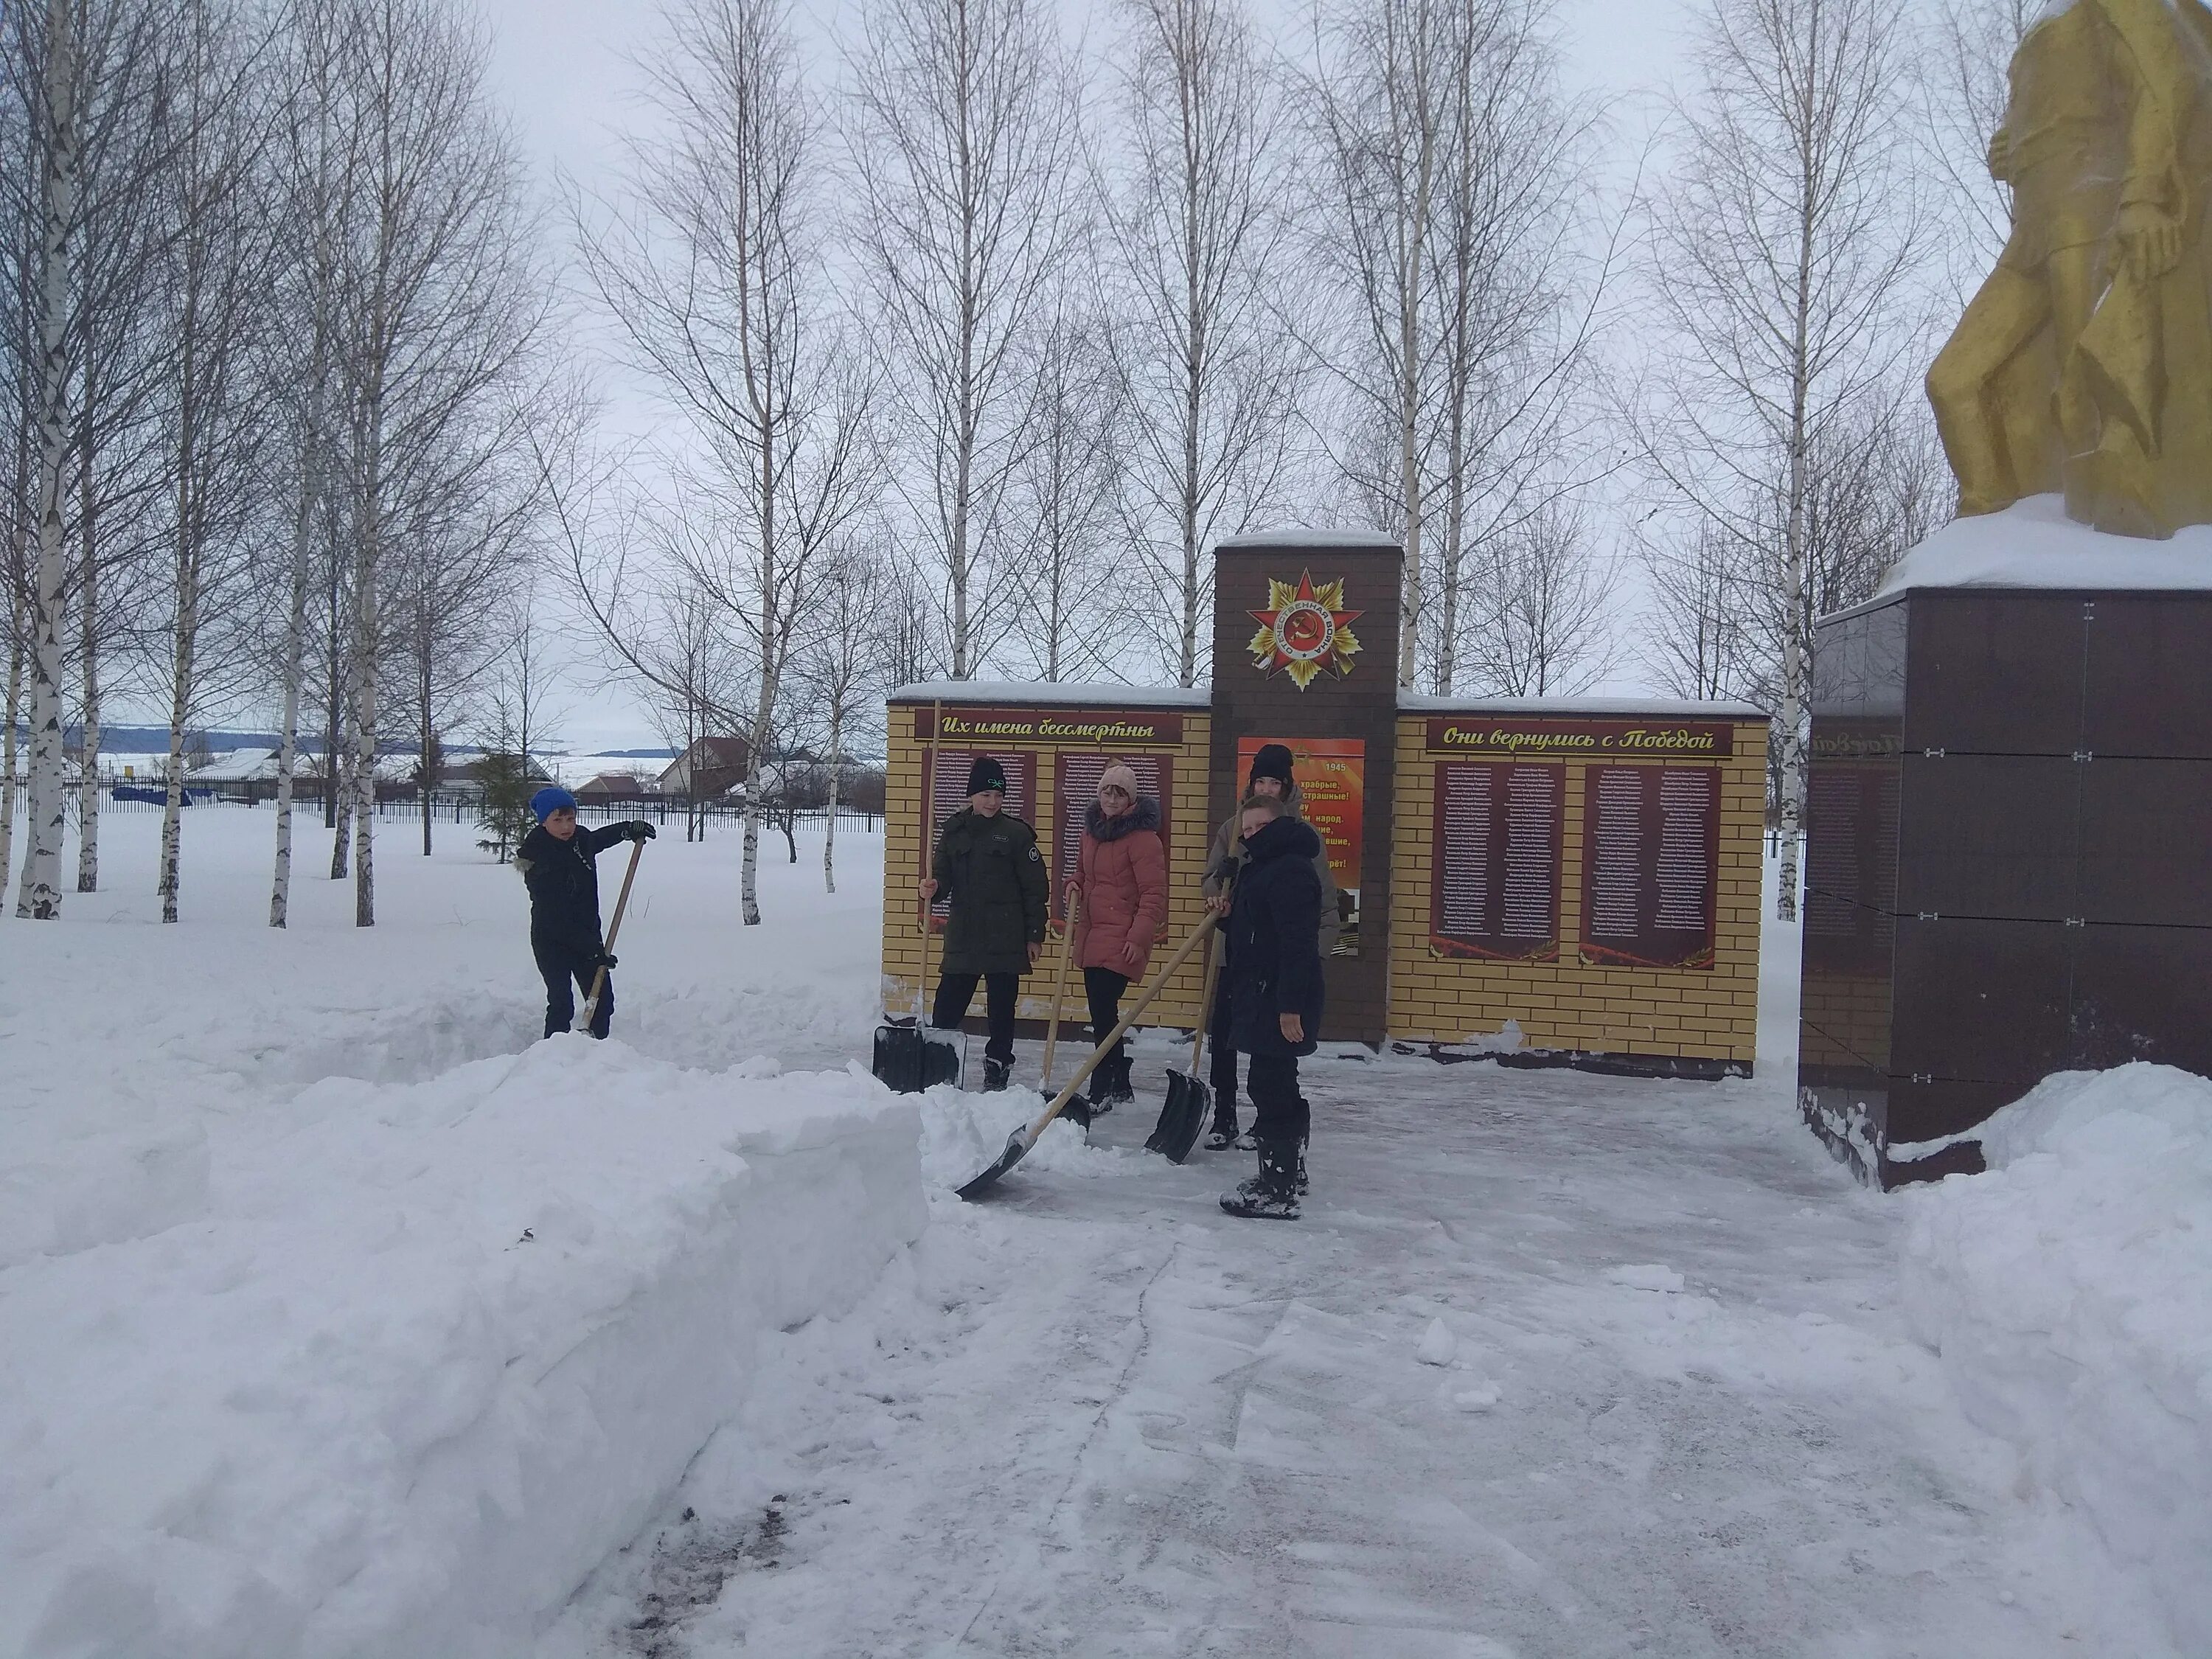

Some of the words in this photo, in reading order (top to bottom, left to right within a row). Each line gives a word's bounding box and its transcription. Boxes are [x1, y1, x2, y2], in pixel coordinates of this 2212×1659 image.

[1276, 602, 1329, 654] ОТЕЧЕСТВЕННАЯ
[942, 717, 970, 732] Их
[974, 722, 1033, 734] имена
[1038, 717, 1155, 742] бессмертны
[1444, 727, 1484, 744] Они
[1489, 729, 1595, 751] вернулись
[1601, 735, 1613, 747] с
[1618, 729, 1714, 748] Победой
[1326, 763, 1346, 771] 1945
[1301, 780, 1340, 790] храбрые,
[1302, 792, 1350, 801] страшные!
[1299, 804, 1310, 812] ву
[1315, 815, 1344, 824] народ.
[1325, 838, 1351, 846] вшие,
[1327, 859, 1346, 869] рёт!
